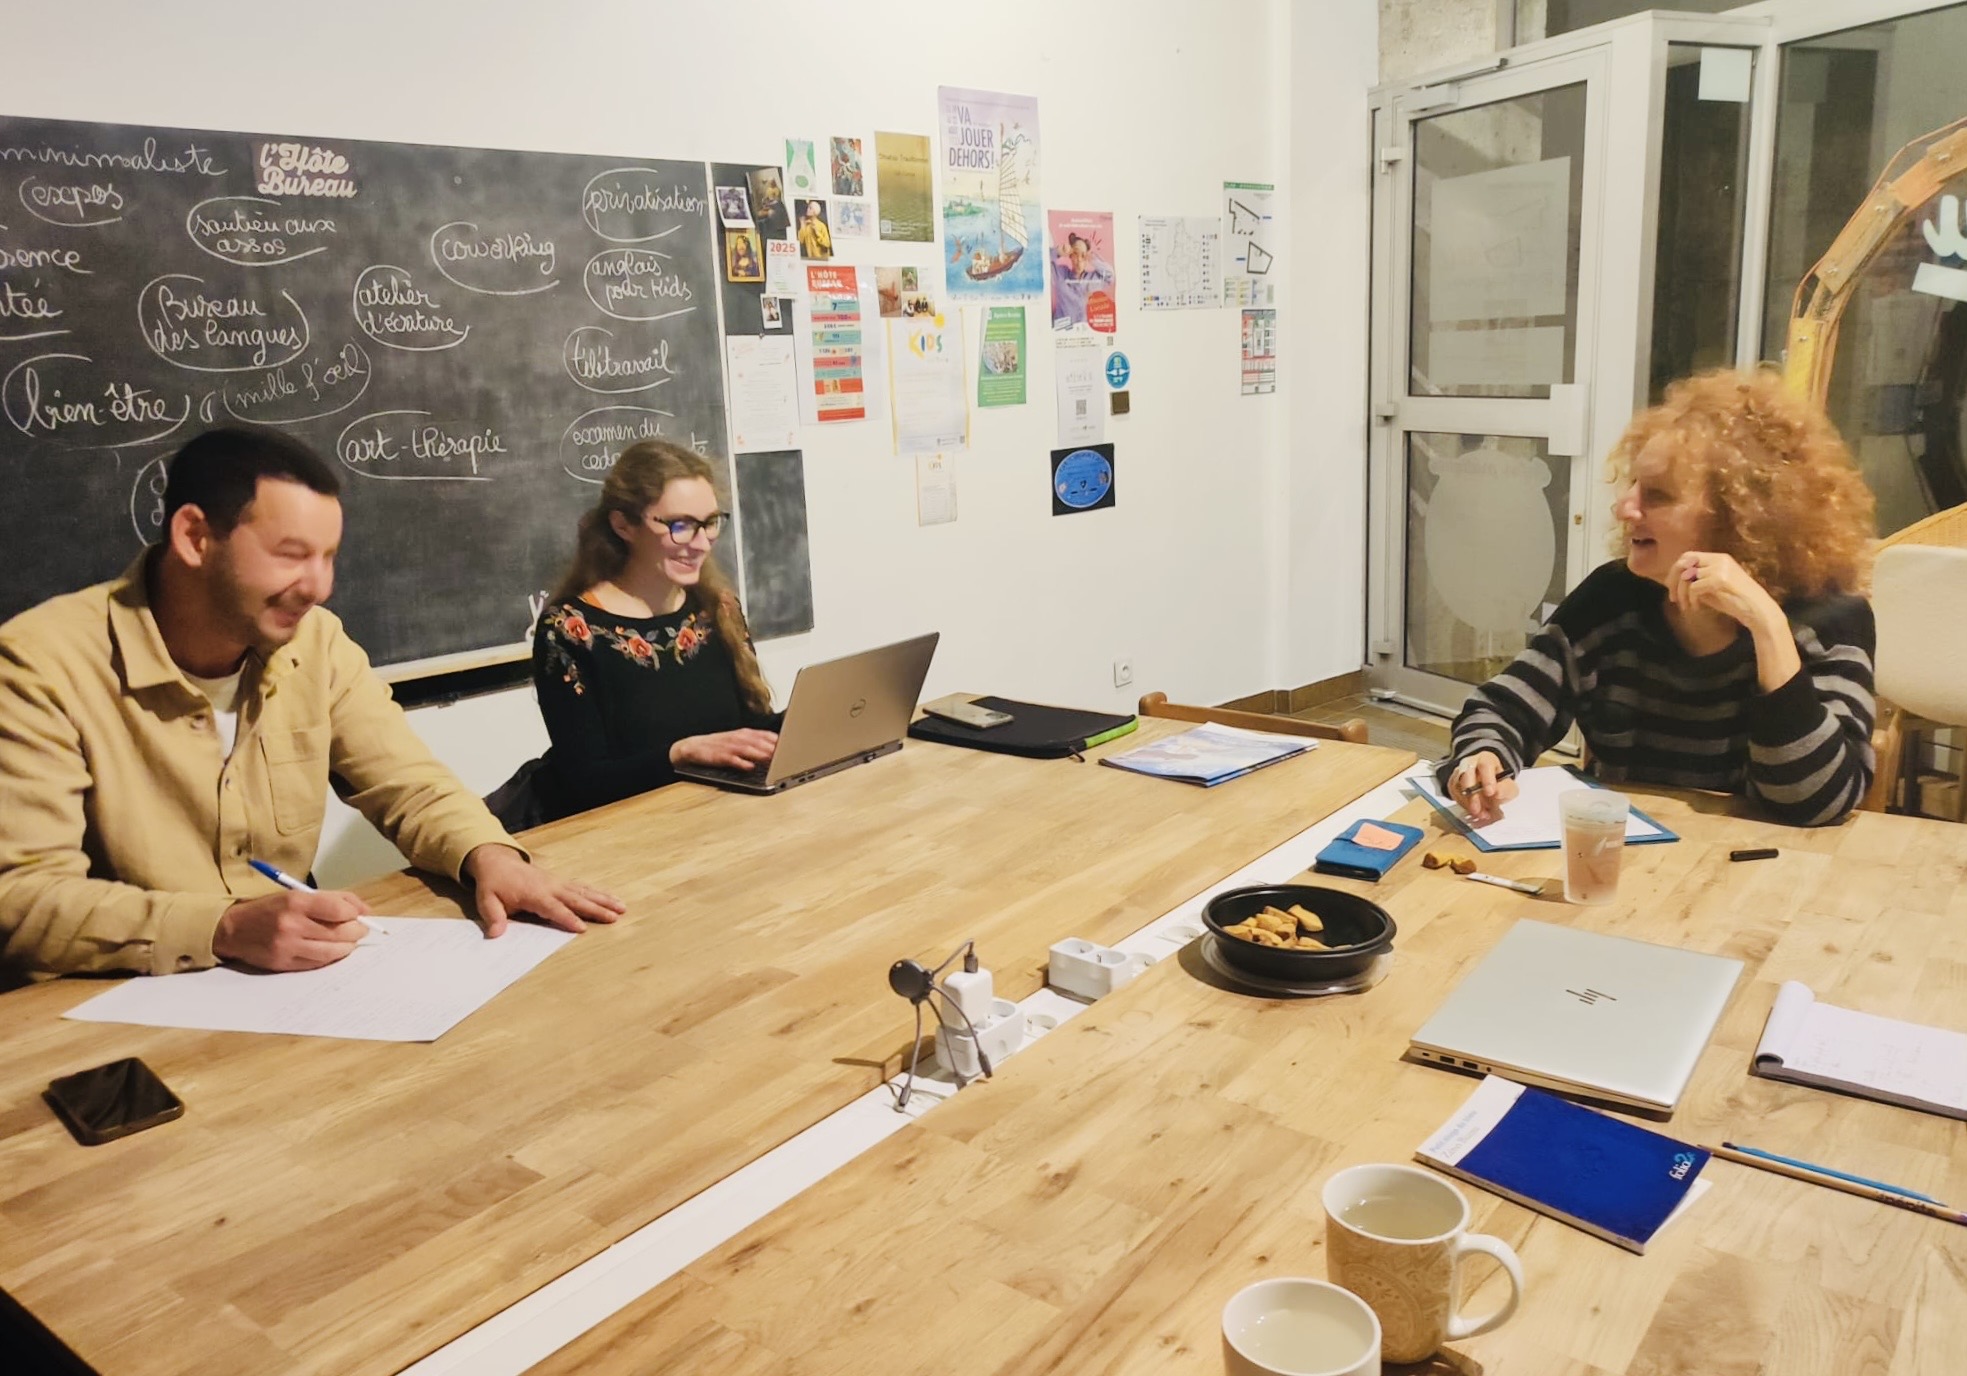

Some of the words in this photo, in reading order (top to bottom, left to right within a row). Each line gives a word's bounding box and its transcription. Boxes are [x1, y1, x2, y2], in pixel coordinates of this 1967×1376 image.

[957, 105, 972, 125] VA
[960, 126, 994, 148] JOUER
[0, 137, 228, 176] minimaliste
[949, 147, 994, 170] DEHORS!
[258, 166, 358, 198] Bureau
[31, 182, 124, 218] expos
[585, 186, 704, 232] privatisation
[285, 219, 337, 233] aux
[442, 231, 555, 275] coworking
[770, 242, 797, 253] 2025
[592, 251, 662, 282] anglais
[158, 285, 267, 322] Bureau
[358, 275, 441, 308] atelier
[605, 284, 648, 311] pour
[361, 312, 464, 337] d'écriture
[153, 321, 200, 352] des
[204, 319, 302, 366] langues
[572, 424, 637, 446] examen
[639, 417, 663, 438] du
